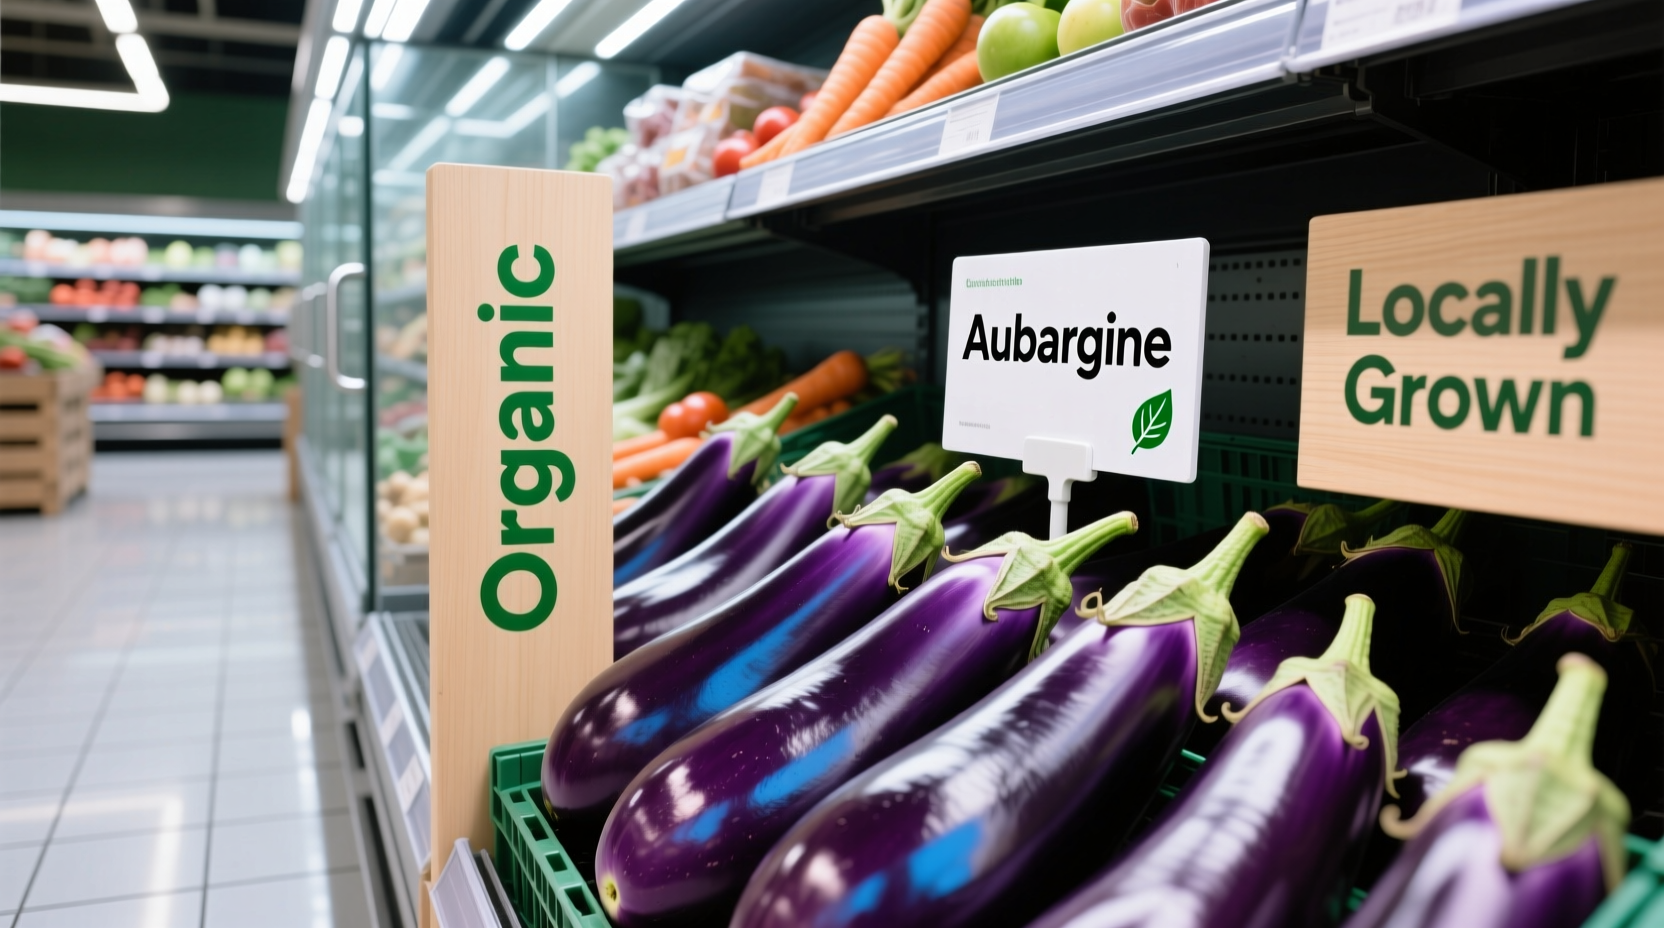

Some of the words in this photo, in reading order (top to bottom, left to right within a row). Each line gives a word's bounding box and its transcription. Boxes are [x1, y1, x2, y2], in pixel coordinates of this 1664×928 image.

[962, 311, 1172, 380] Aubargine
[1346, 255, 1617, 360] Locally
[477, 244, 576, 632] Organic
[1344, 354, 1596, 437] Grown
